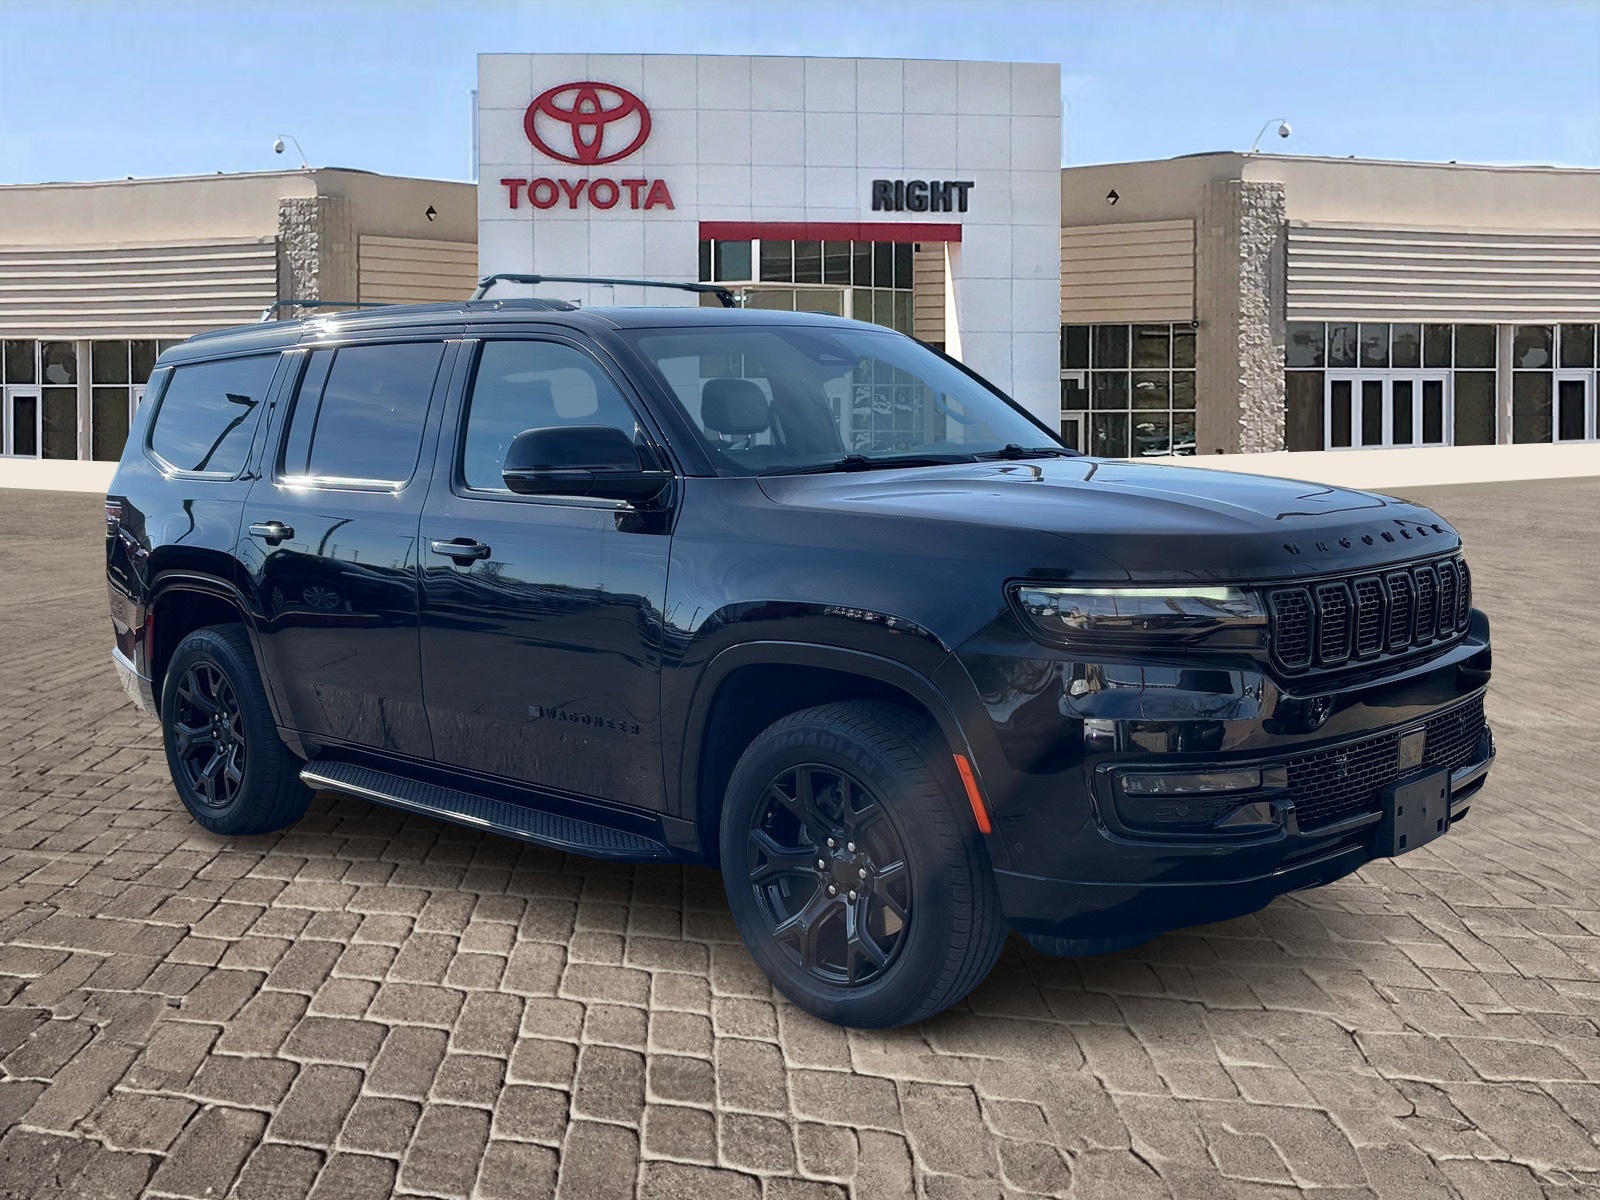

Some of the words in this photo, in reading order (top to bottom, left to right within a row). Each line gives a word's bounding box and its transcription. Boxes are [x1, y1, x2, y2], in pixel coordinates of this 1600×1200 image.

[501, 179, 675, 209] TOYOTA
[872, 181, 975, 212] RIGHT
[546, 709, 640, 735] WAGONEER
